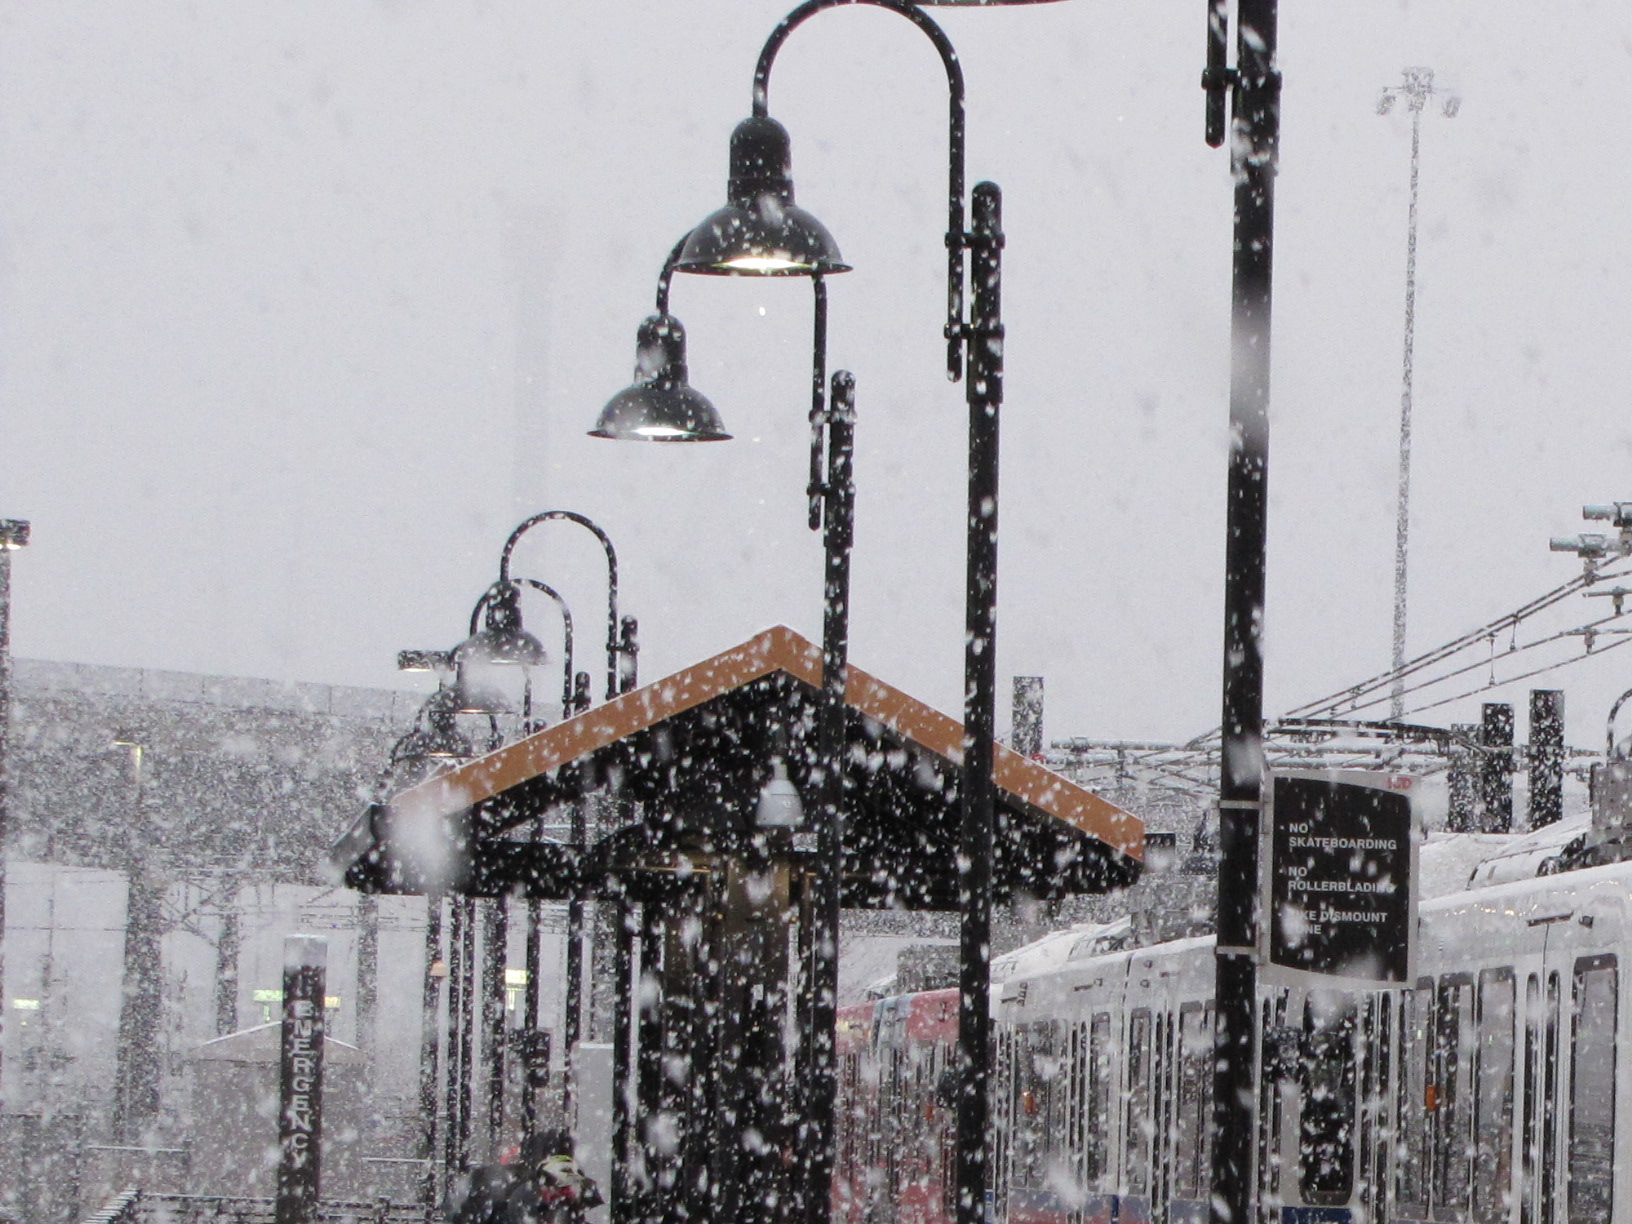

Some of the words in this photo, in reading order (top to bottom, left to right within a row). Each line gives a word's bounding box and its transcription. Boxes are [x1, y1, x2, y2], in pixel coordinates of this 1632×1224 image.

[1289, 823, 1309, 833] NO
[1288, 837, 1397, 850] SKATEBOARDING
[1288, 867, 1308, 877] NO
[1320, 911, 1388, 923] DISMOUNT
[292, 1000, 315, 1168] EMERGENCY
